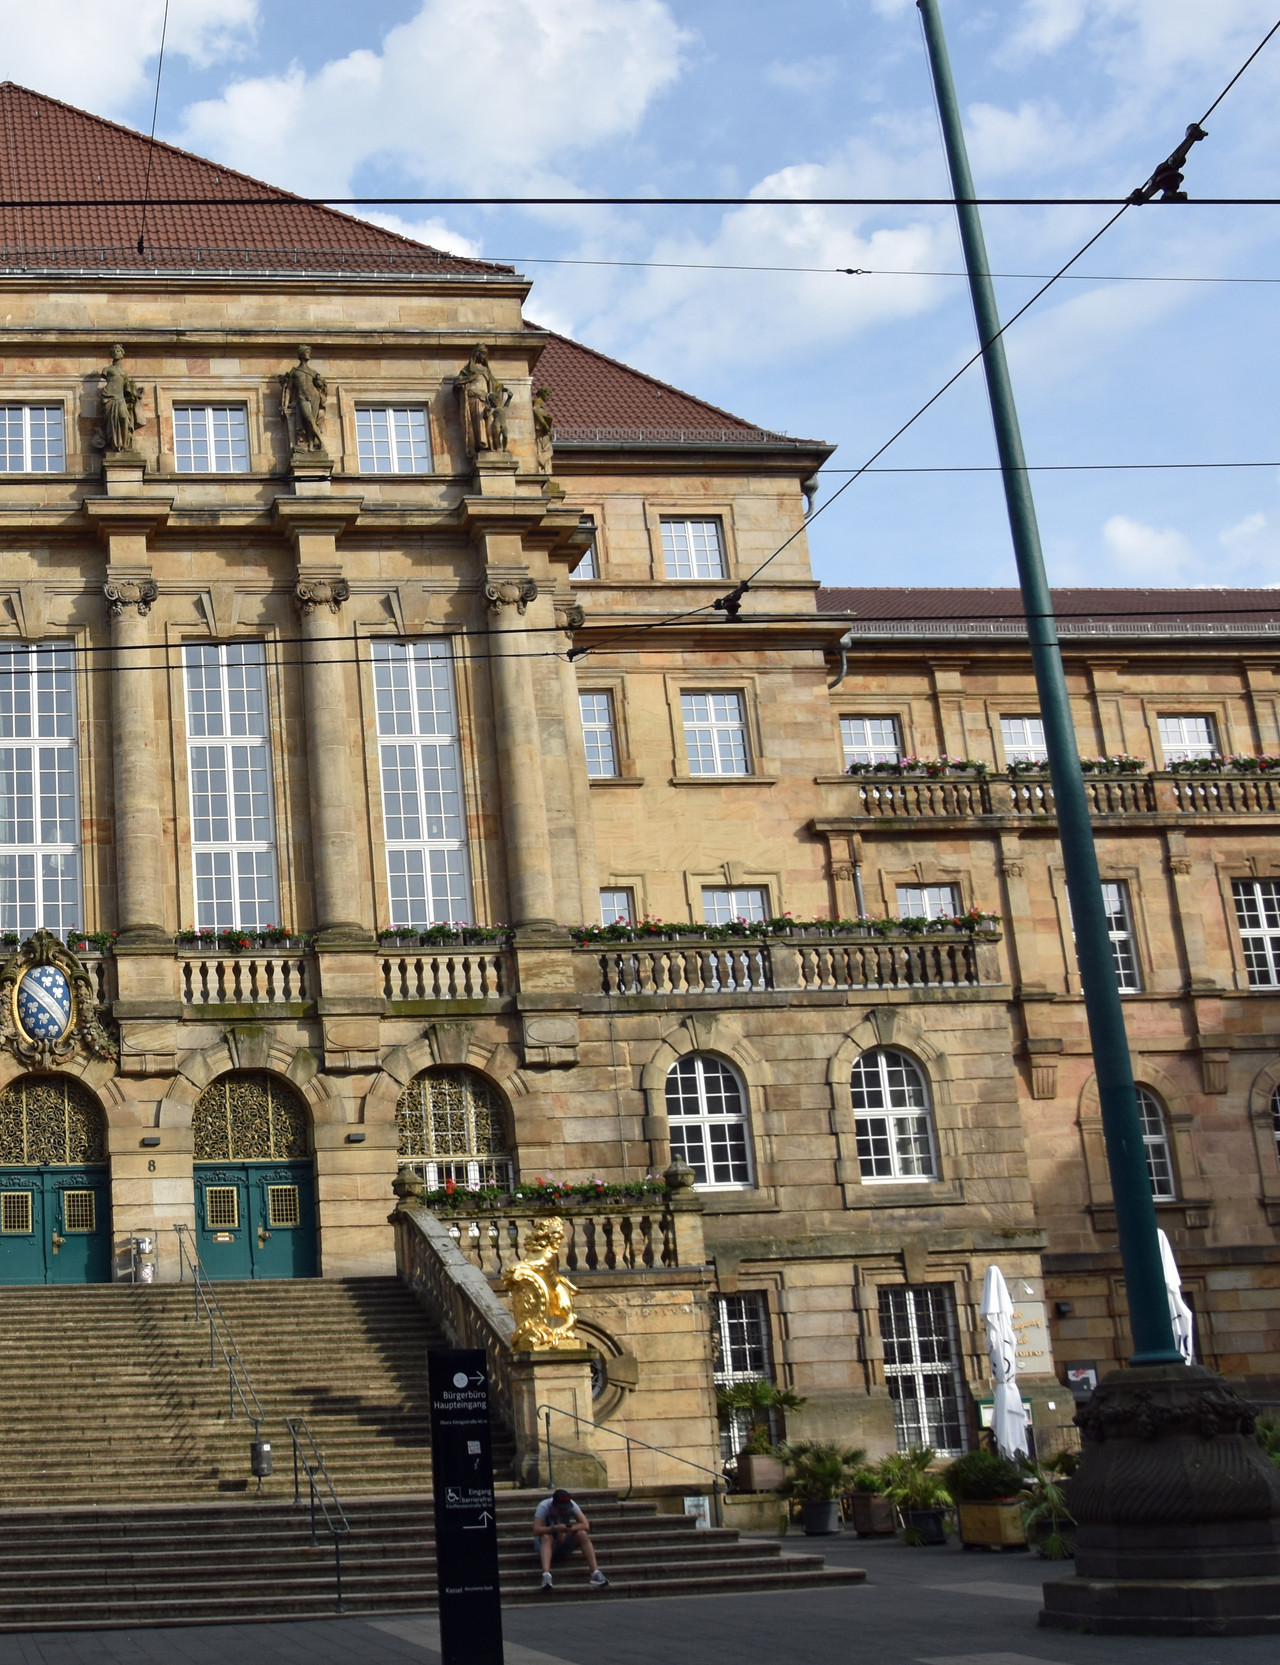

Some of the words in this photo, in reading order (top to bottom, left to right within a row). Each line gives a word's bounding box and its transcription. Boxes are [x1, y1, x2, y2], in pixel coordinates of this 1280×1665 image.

[147, 1159, 156, 1172] 8
[443, 1390, 487, 1400] Bürgerbüro
[433, 1401, 487, 1410] Haupteingang
